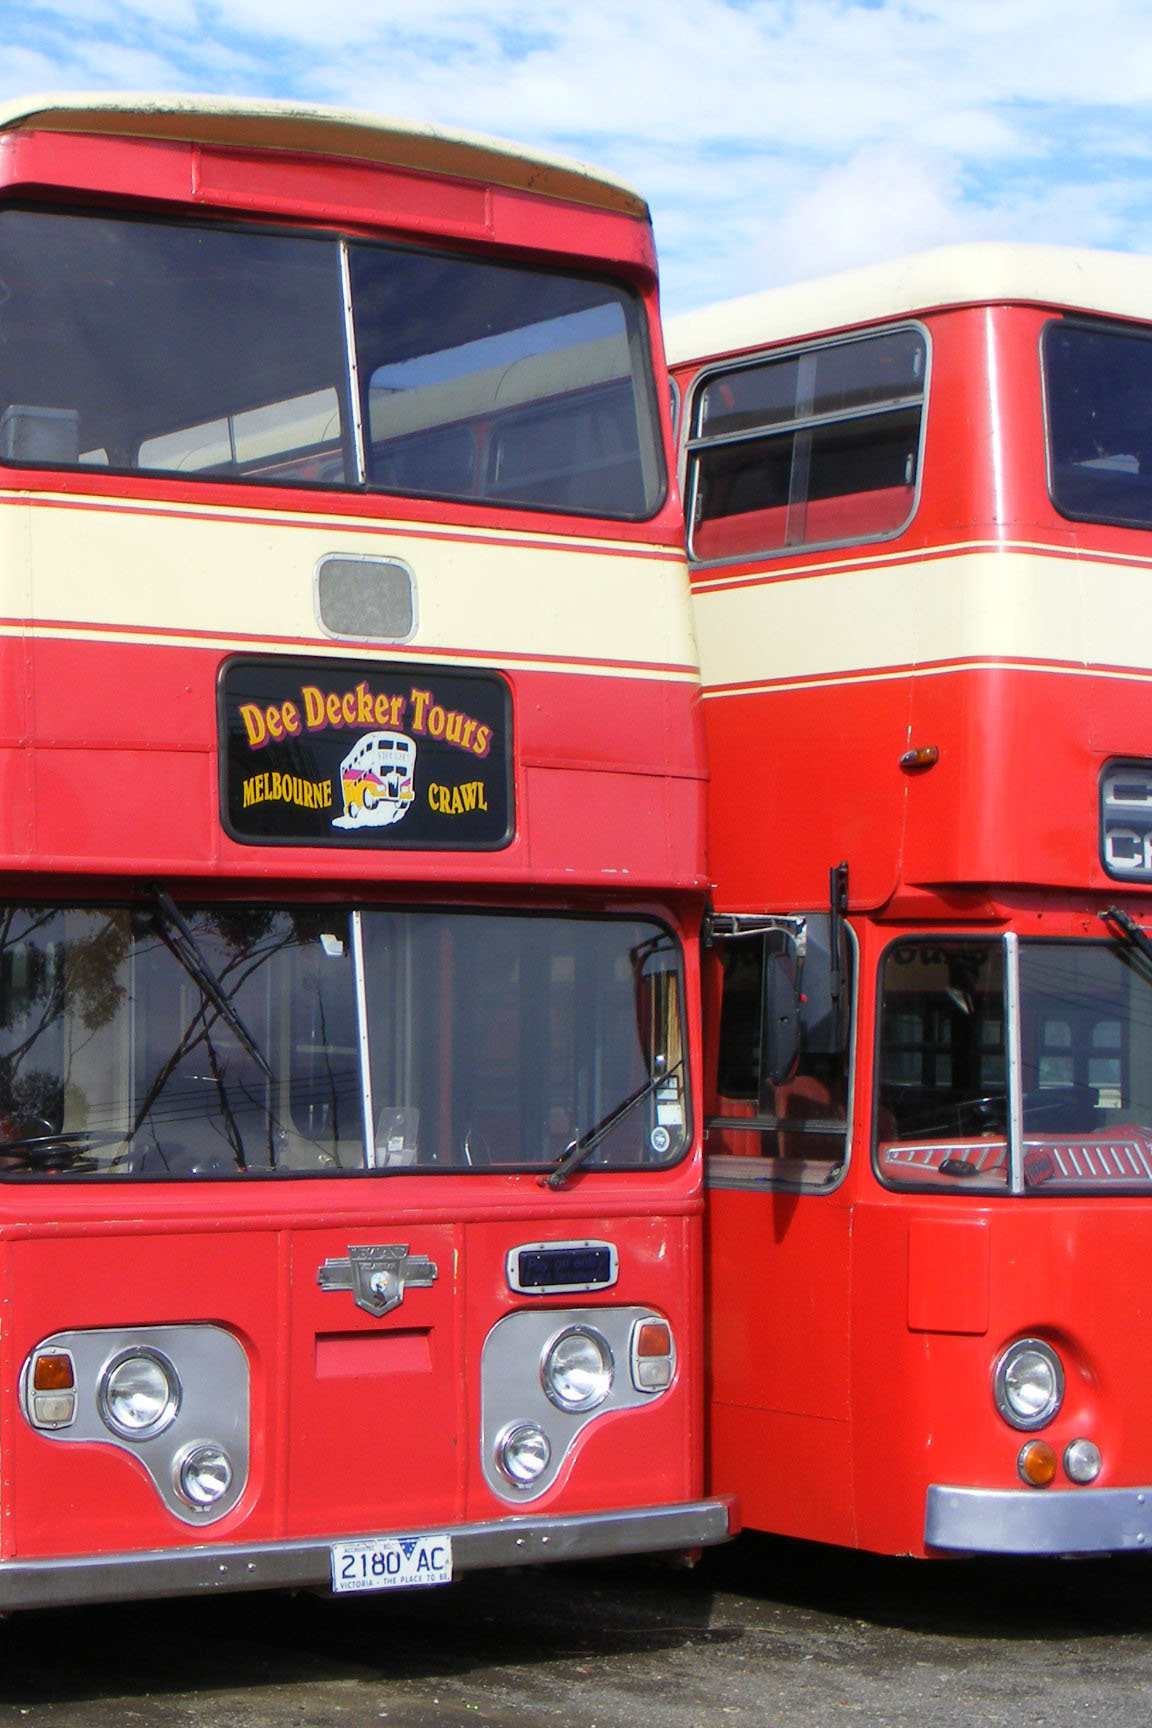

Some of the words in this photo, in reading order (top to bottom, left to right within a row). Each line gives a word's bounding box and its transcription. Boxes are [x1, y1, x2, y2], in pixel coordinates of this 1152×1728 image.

[239, 701, 299, 748] Dee
[301, 680, 404, 729] Decker
[410, 687, 493, 758] Tours
[243, 772, 333, 809] MELBOURNE
[427, 782, 488, 815] CRAWL
[341, 1551, 401, 1579] 2180
[416, 1547, 445, 1572] AC
[340, 1579, 373, 1590] VICTORIA
[383, 1577, 396, 1585] THE
[401, 1575, 422, 1583] PLACE
